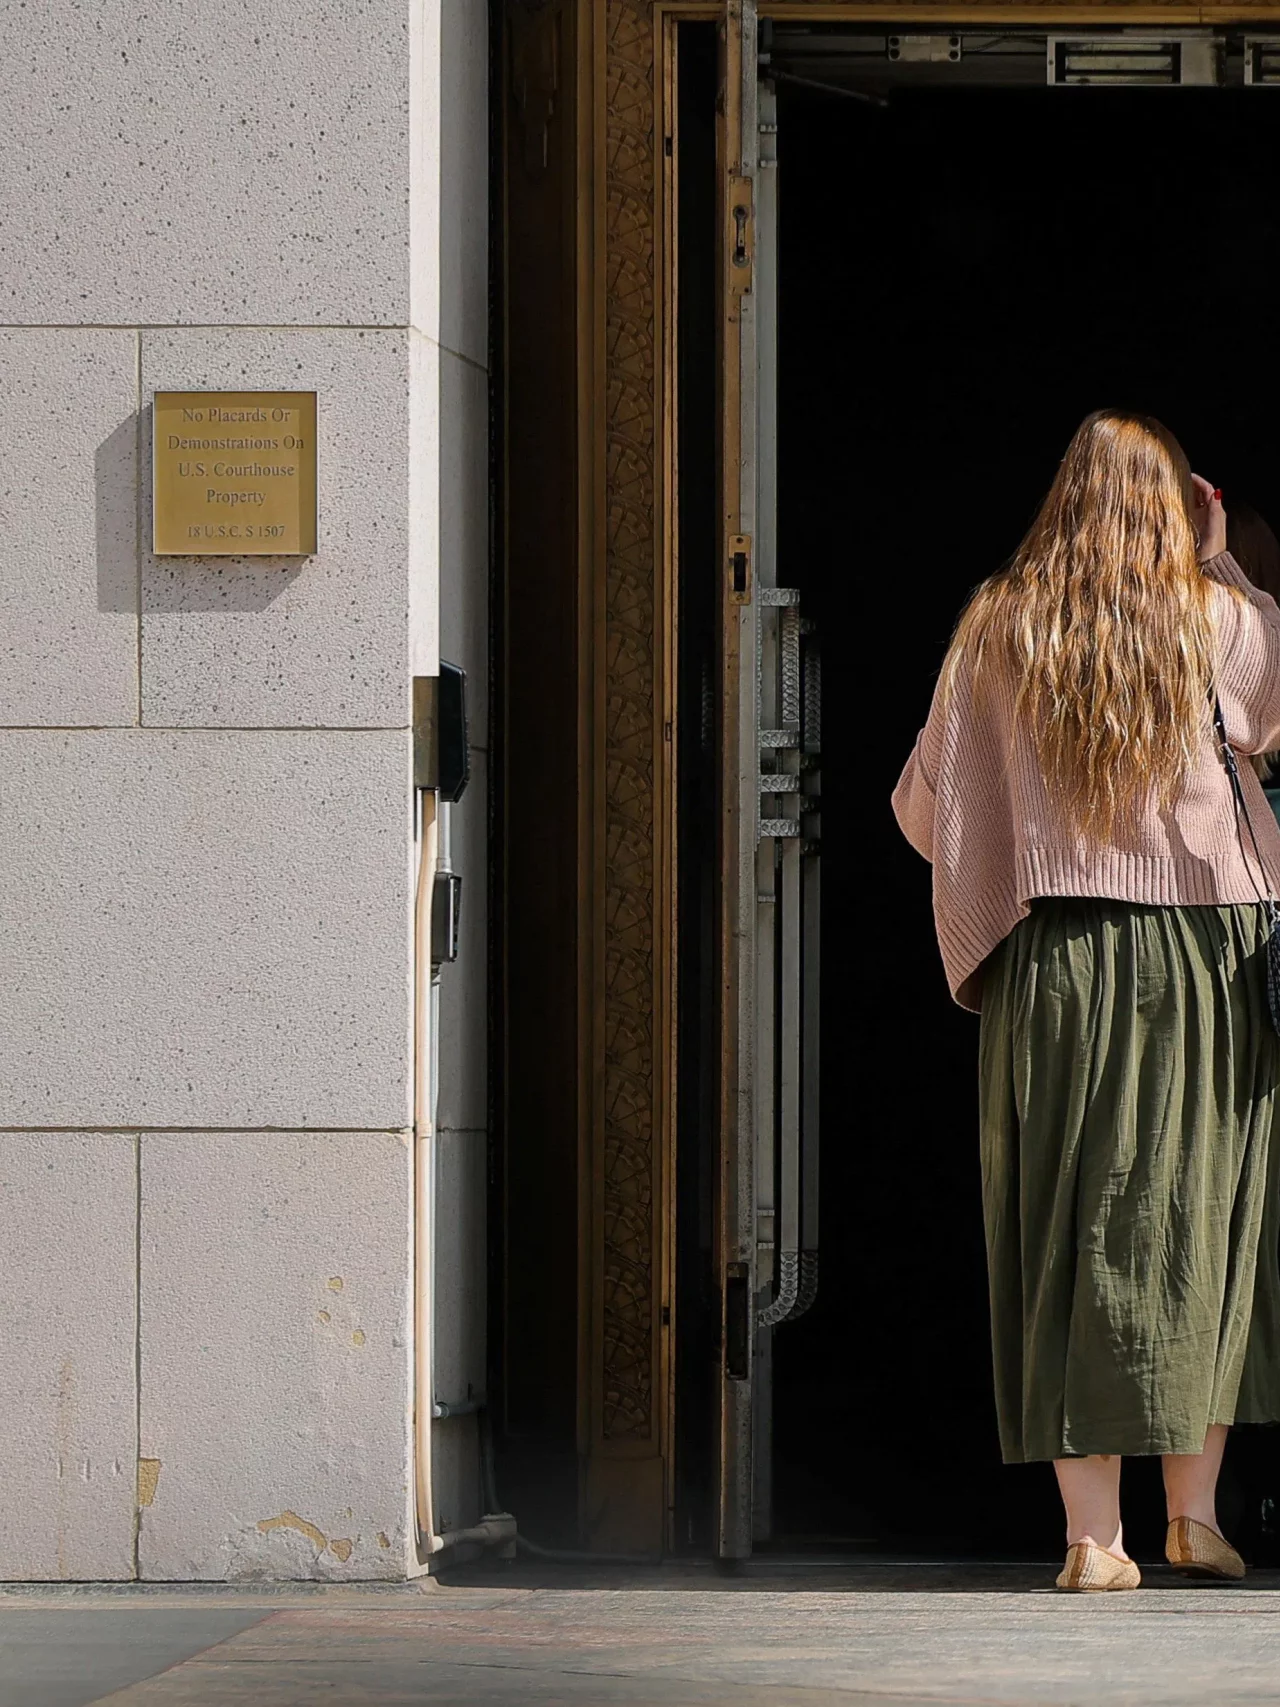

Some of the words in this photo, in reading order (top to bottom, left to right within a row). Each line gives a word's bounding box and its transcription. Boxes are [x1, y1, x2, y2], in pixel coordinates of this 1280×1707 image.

[182, 408, 203, 422] No
[208, 408, 267, 422] Placards
[271, 408, 291, 422] Or
[168, 435, 278, 449] Demonstrations
[283, 435, 304, 449] On
[179, 462, 209, 477] U.S.
[213, 462, 295, 477] Courthouse
[206, 489, 266, 506] Property
[188, 526, 200, 538] 18
[204, 525, 242, 538] U.S.C.
[258, 526, 285, 538] 1507
